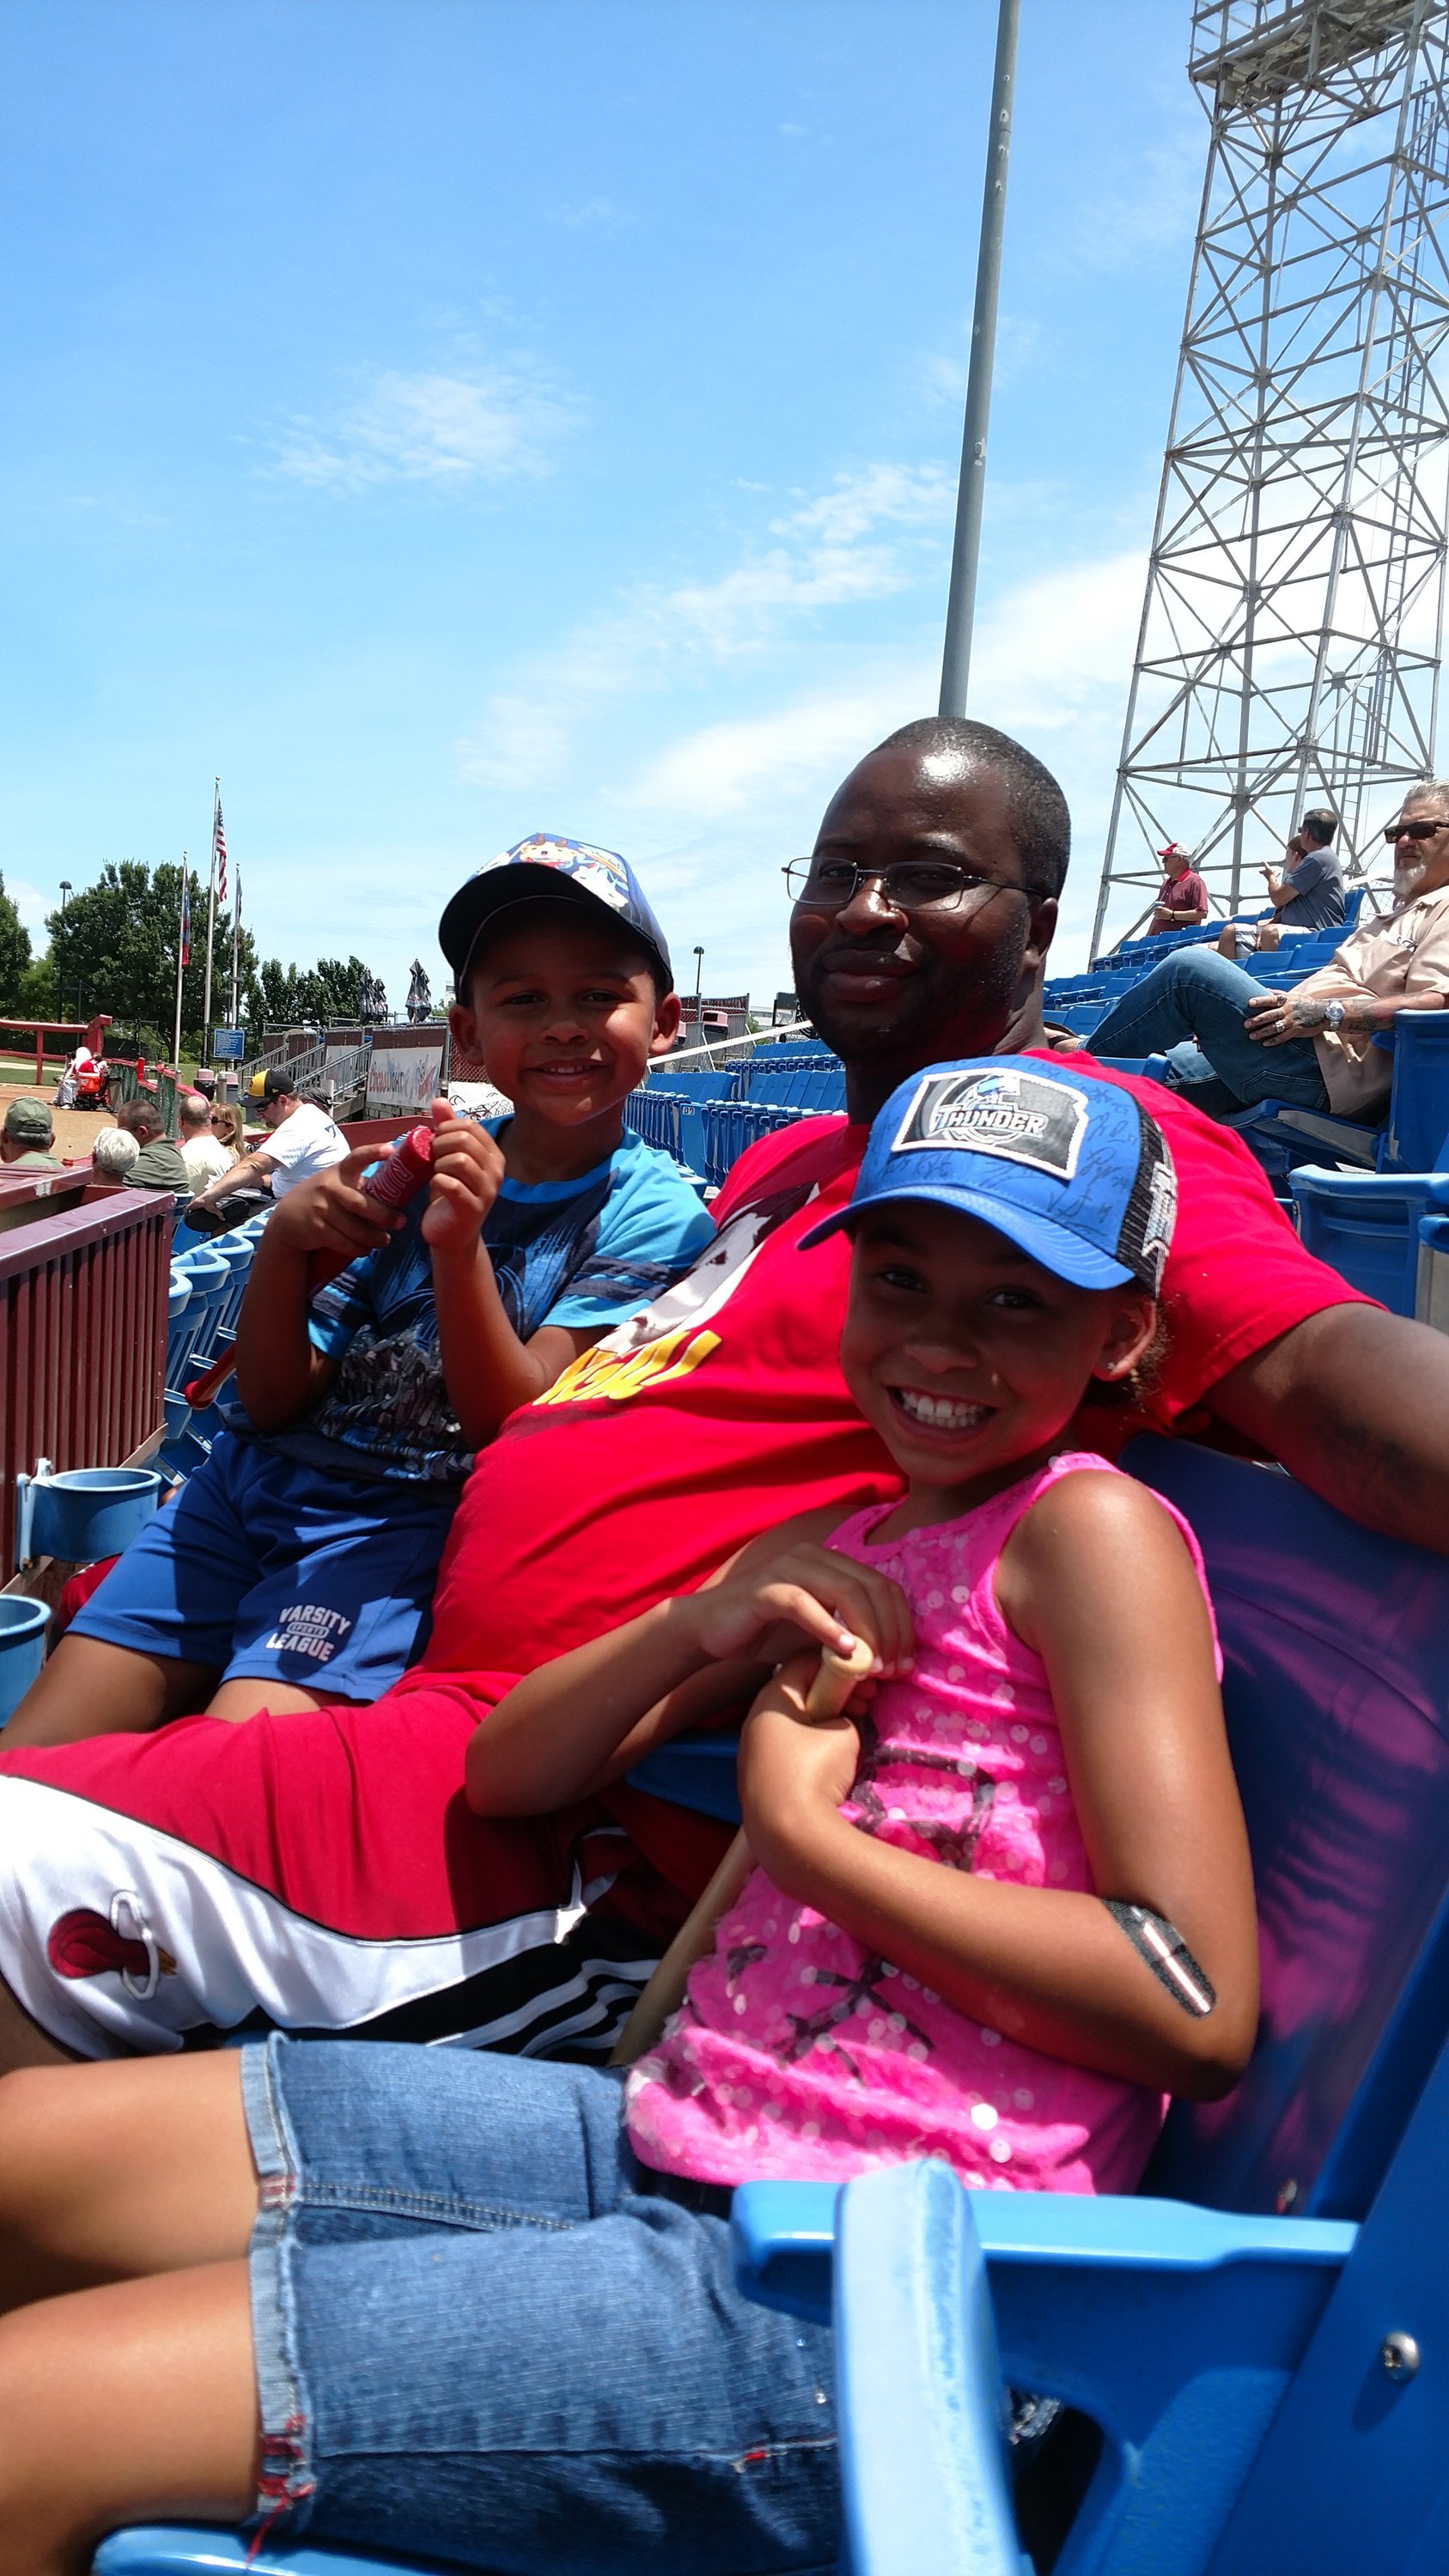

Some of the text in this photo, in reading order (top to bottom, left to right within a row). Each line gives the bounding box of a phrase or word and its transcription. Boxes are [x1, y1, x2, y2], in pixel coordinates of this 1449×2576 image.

[935, 1105, 1046, 1135] THUNDER
[279, 1605, 351, 1635] VARSITY
[265, 1632, 335, 1662] LEAGUE
